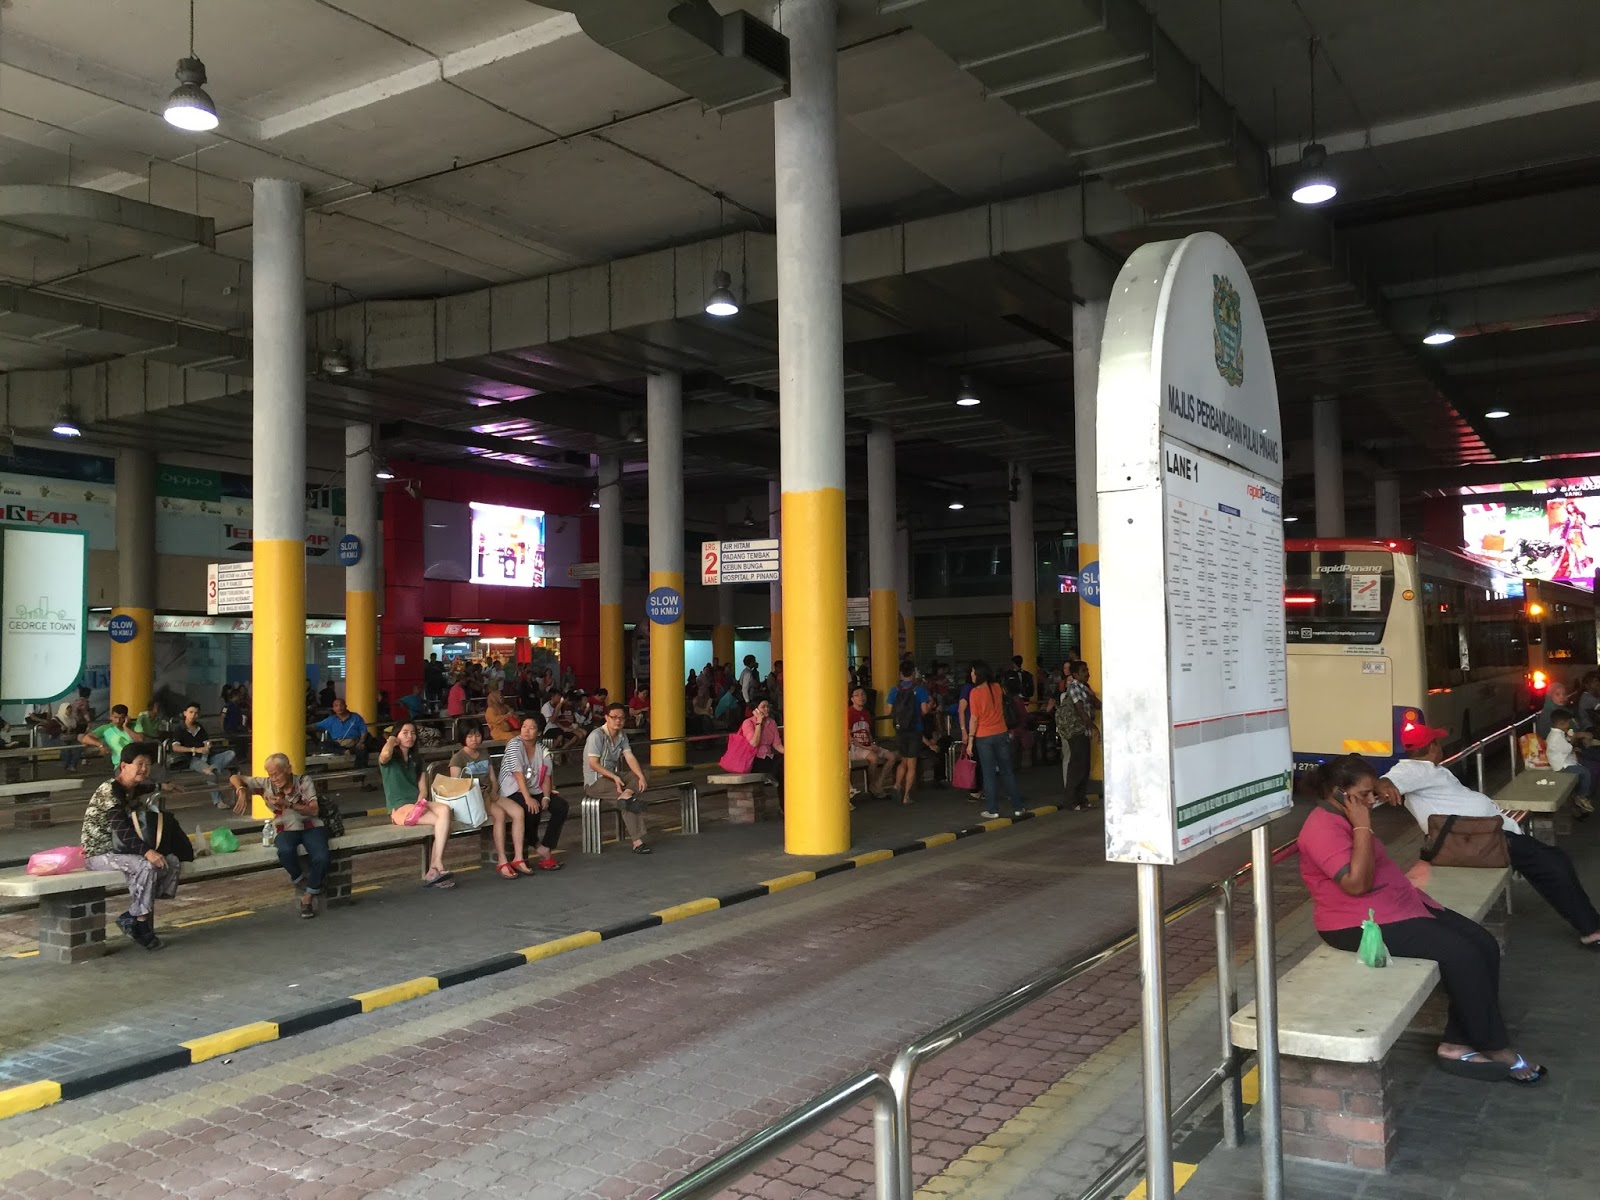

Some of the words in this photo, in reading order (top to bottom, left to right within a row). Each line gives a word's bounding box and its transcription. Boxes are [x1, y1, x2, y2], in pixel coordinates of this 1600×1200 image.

[1168, 384, 1195, 423] MAJLIS
[1196, 398, 1242, 445] PERBANDARAN
[1242, 423, 1259, 455] PULAU
[1259, 434, 1278, 464] PINANG
[1166, 450, 1191, 481] LANE
[1194, 462, 1198, 483] 1
[1247, 484, 1280, 509] rapidPenang
[340, 542, 358, 551] SLOW
[704, 552, 718, 575] 2
[723, 563, 742, 571] KEBUN
[743, 562, 763, 570] BUNGA
[1316, 564, 1382, 574] rapidPenang
[704, 576, 718, 584] LANE
[723, 573, 750, 581] HOSPITAL
[209, 581, 217, 598] 3
[1083, 586, 1093, 596] 10
[650, 596, 679, 606] SLOW
[660, 607, 679, 615] KM/J
[9, 620, 47, 630] GEORGE
[50, 621, 76, 631] TOWN
[111, 621, 133, 629] SLOW
